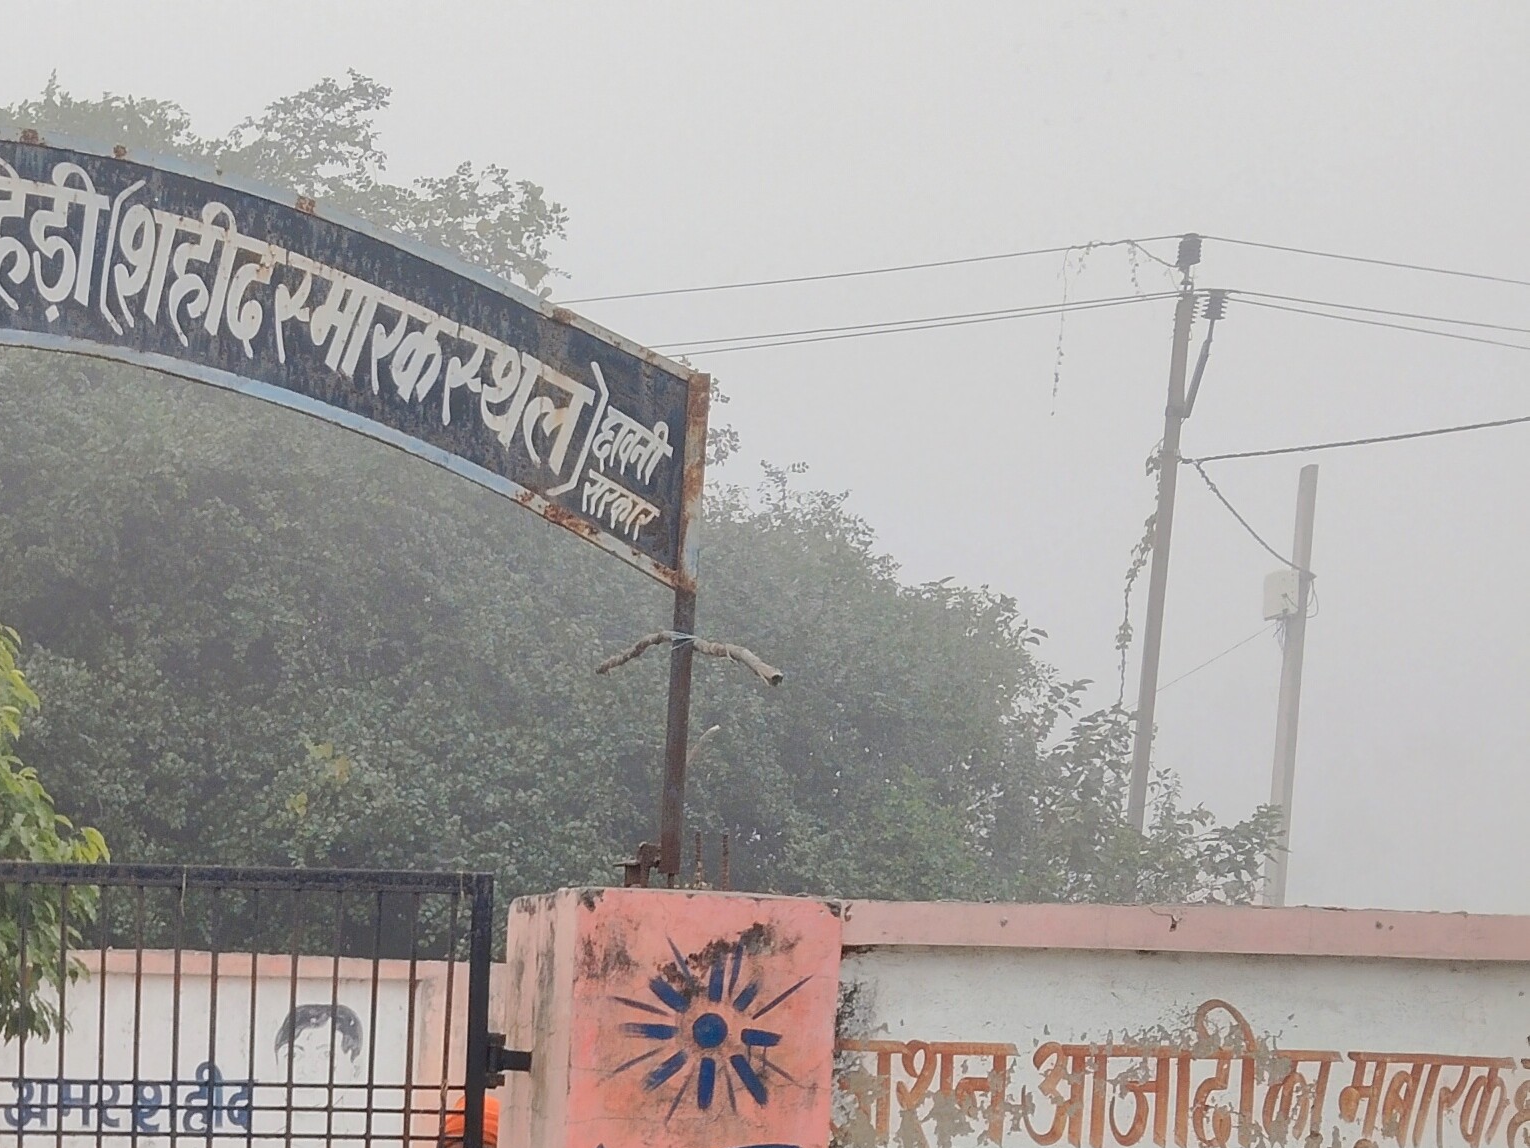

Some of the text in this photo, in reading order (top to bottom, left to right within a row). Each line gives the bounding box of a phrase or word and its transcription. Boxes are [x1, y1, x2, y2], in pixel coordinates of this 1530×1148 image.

[100, 180, 287, 359] (शहीद
[276, 252, 459, 402] स्मारक
[581, 469, 661, 541] सरकार
[1263, 1048, 1342, 1144] का
